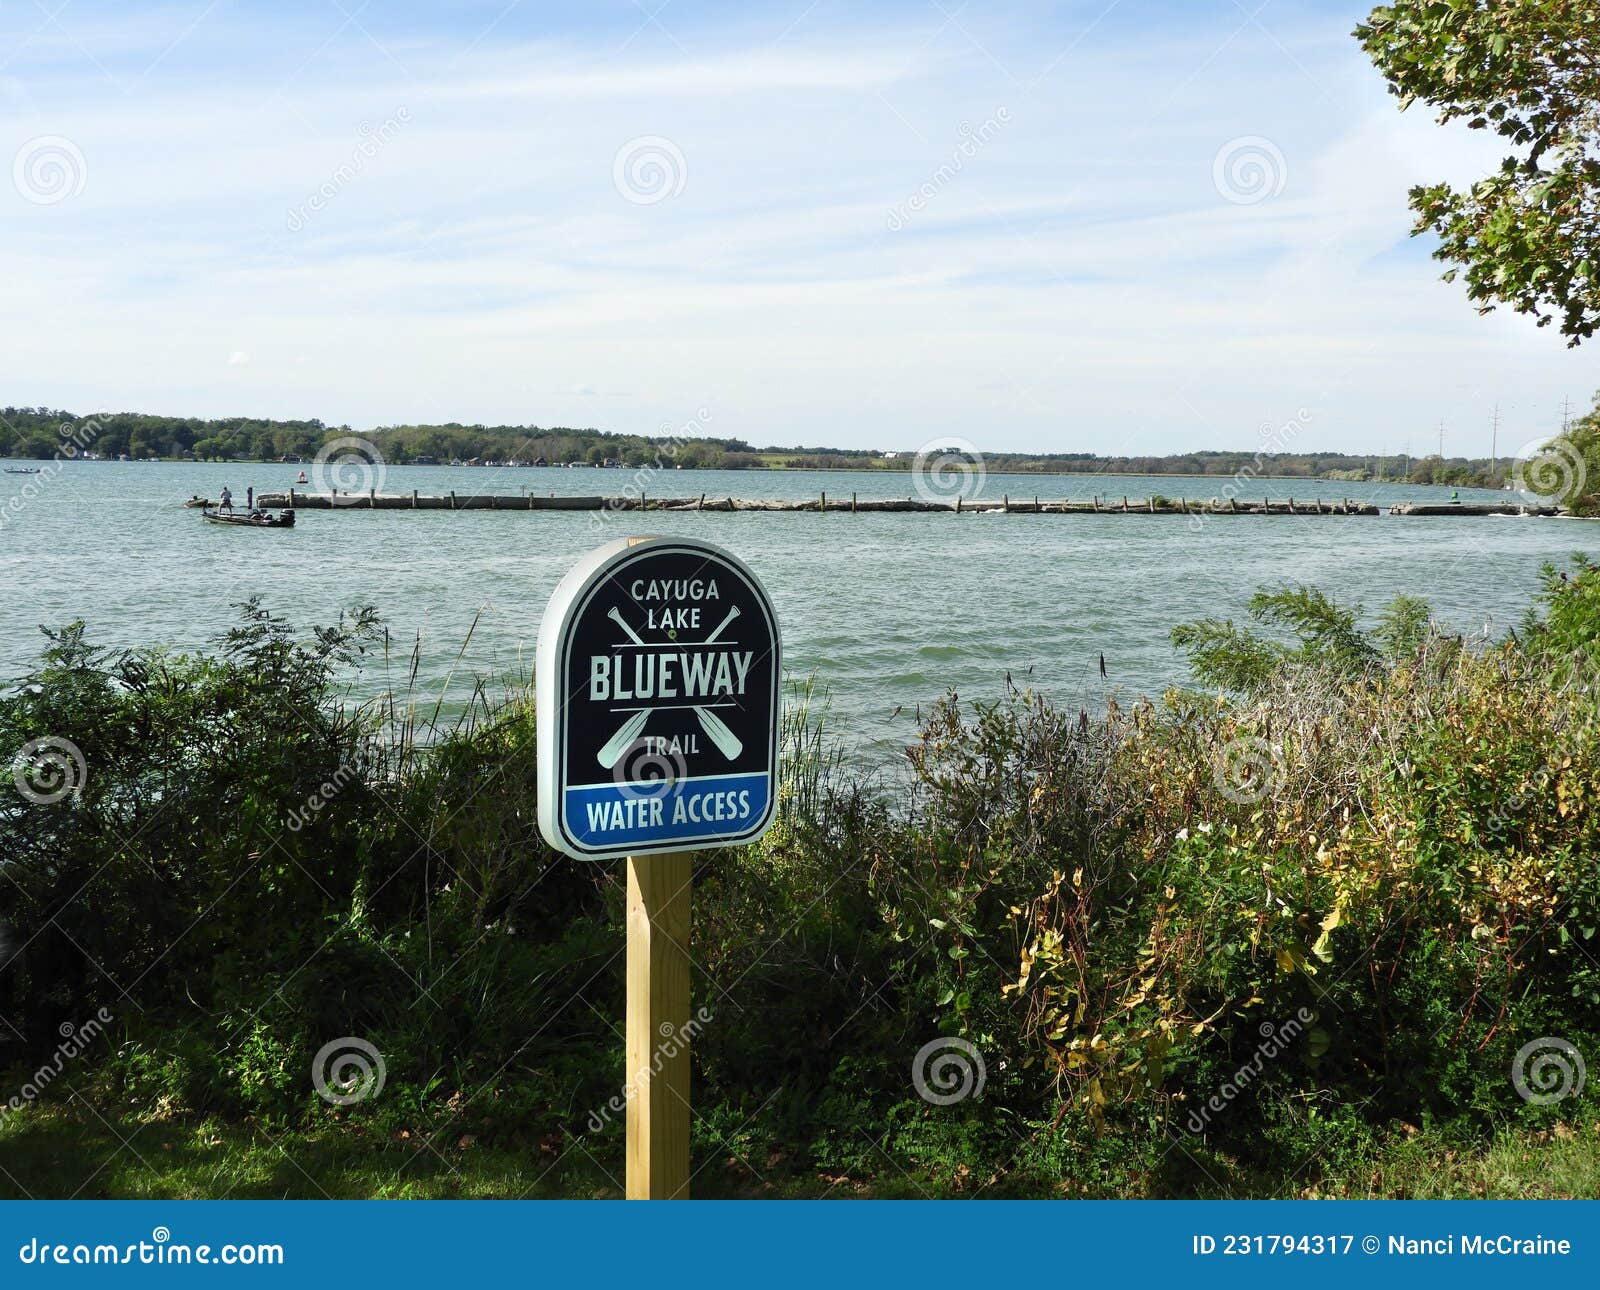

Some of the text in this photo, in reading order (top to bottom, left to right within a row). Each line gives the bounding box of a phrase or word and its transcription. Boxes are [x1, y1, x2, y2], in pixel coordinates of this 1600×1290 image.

[631, 579, 720, 601] CAYUGA
[648, 607, 701, 630] LAKE
[589, 650, 754, 701] BLUEWAY
[644, 734, 700, 757] TRAIL
[586, 790, 750, 833] WATER ACCESS
